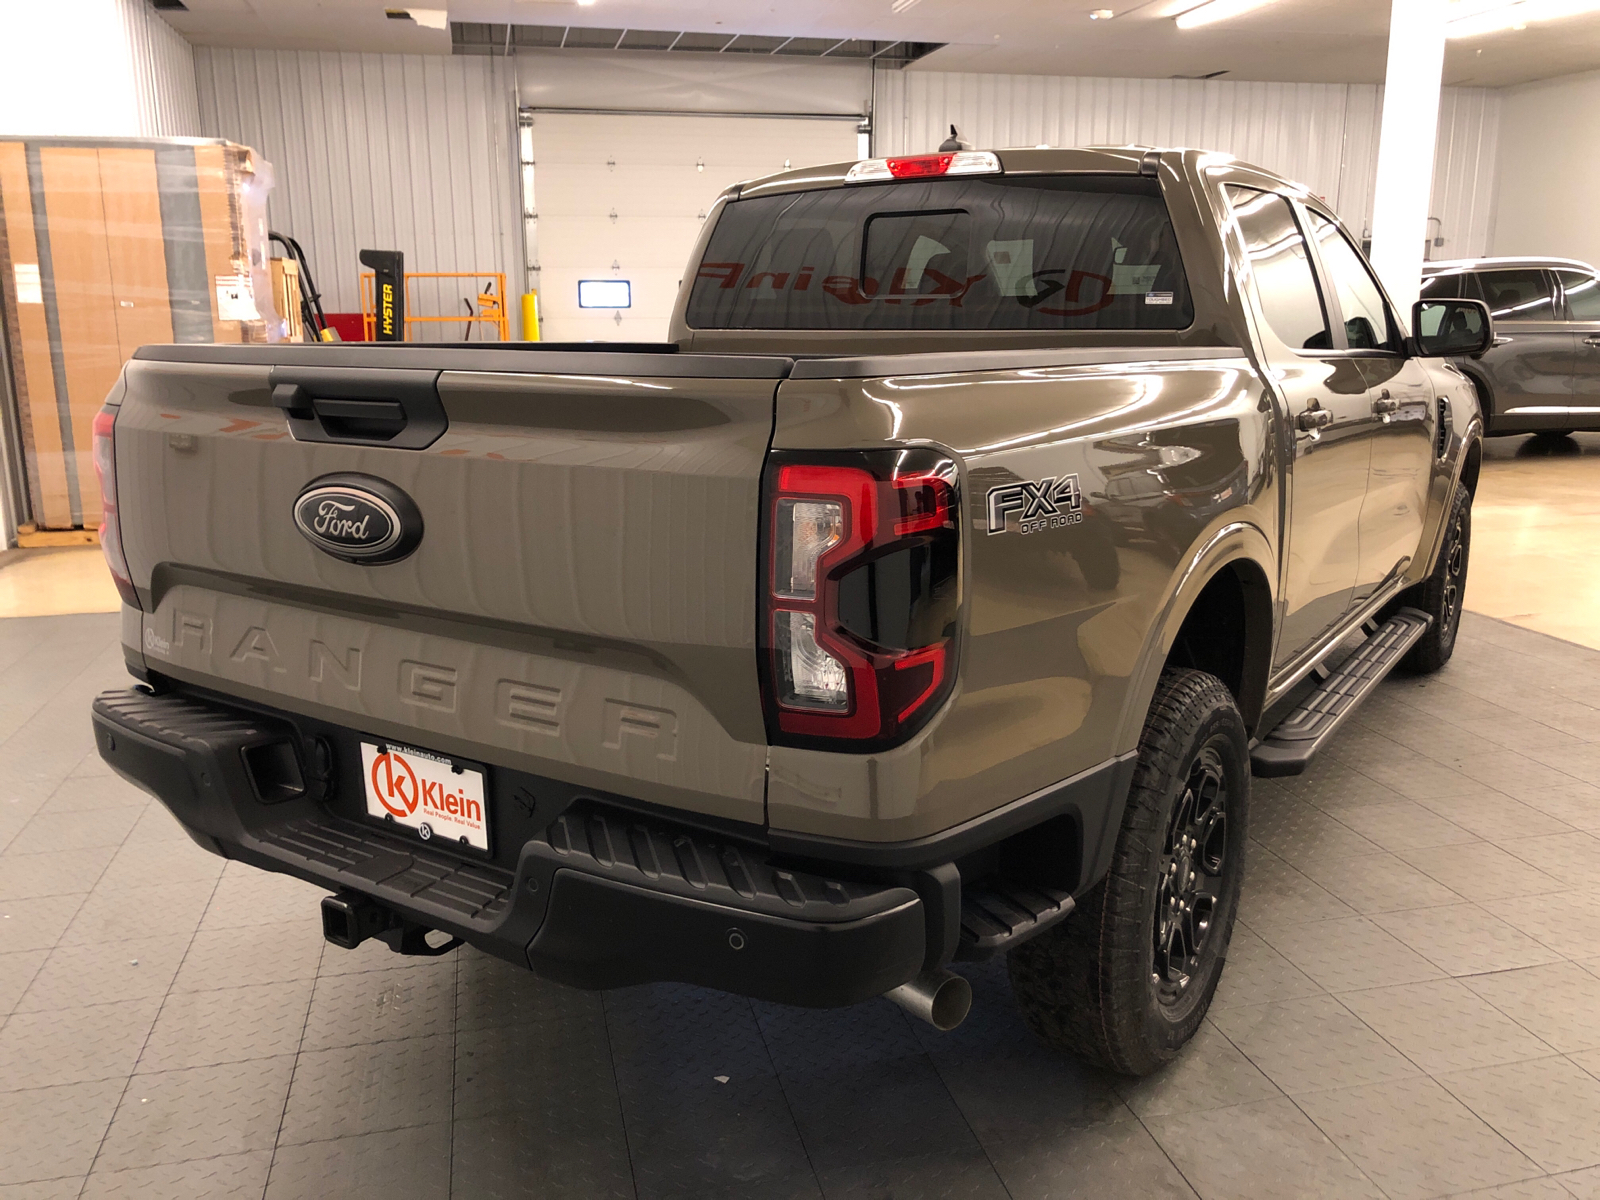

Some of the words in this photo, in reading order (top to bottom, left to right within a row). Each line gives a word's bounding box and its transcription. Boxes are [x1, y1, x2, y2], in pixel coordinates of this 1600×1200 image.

[382, 283, 393, 336] HYSTER
[314, 500, 370, 539] Ford
[986, 473, 1082, 536] FX4
[1020, 519, 1048, 536] OFF
[1050, 512, 1083, 529] ROAD
[172, 607, 678, 762] RANGER
[385, 742, 453, 766] www.kleinauto.com
[421, 778, 482, 822] Klein
[423, 808, 435, 817] Real
[435, 812, 454, 822] People.
[454, 817, 466, 826] Real
